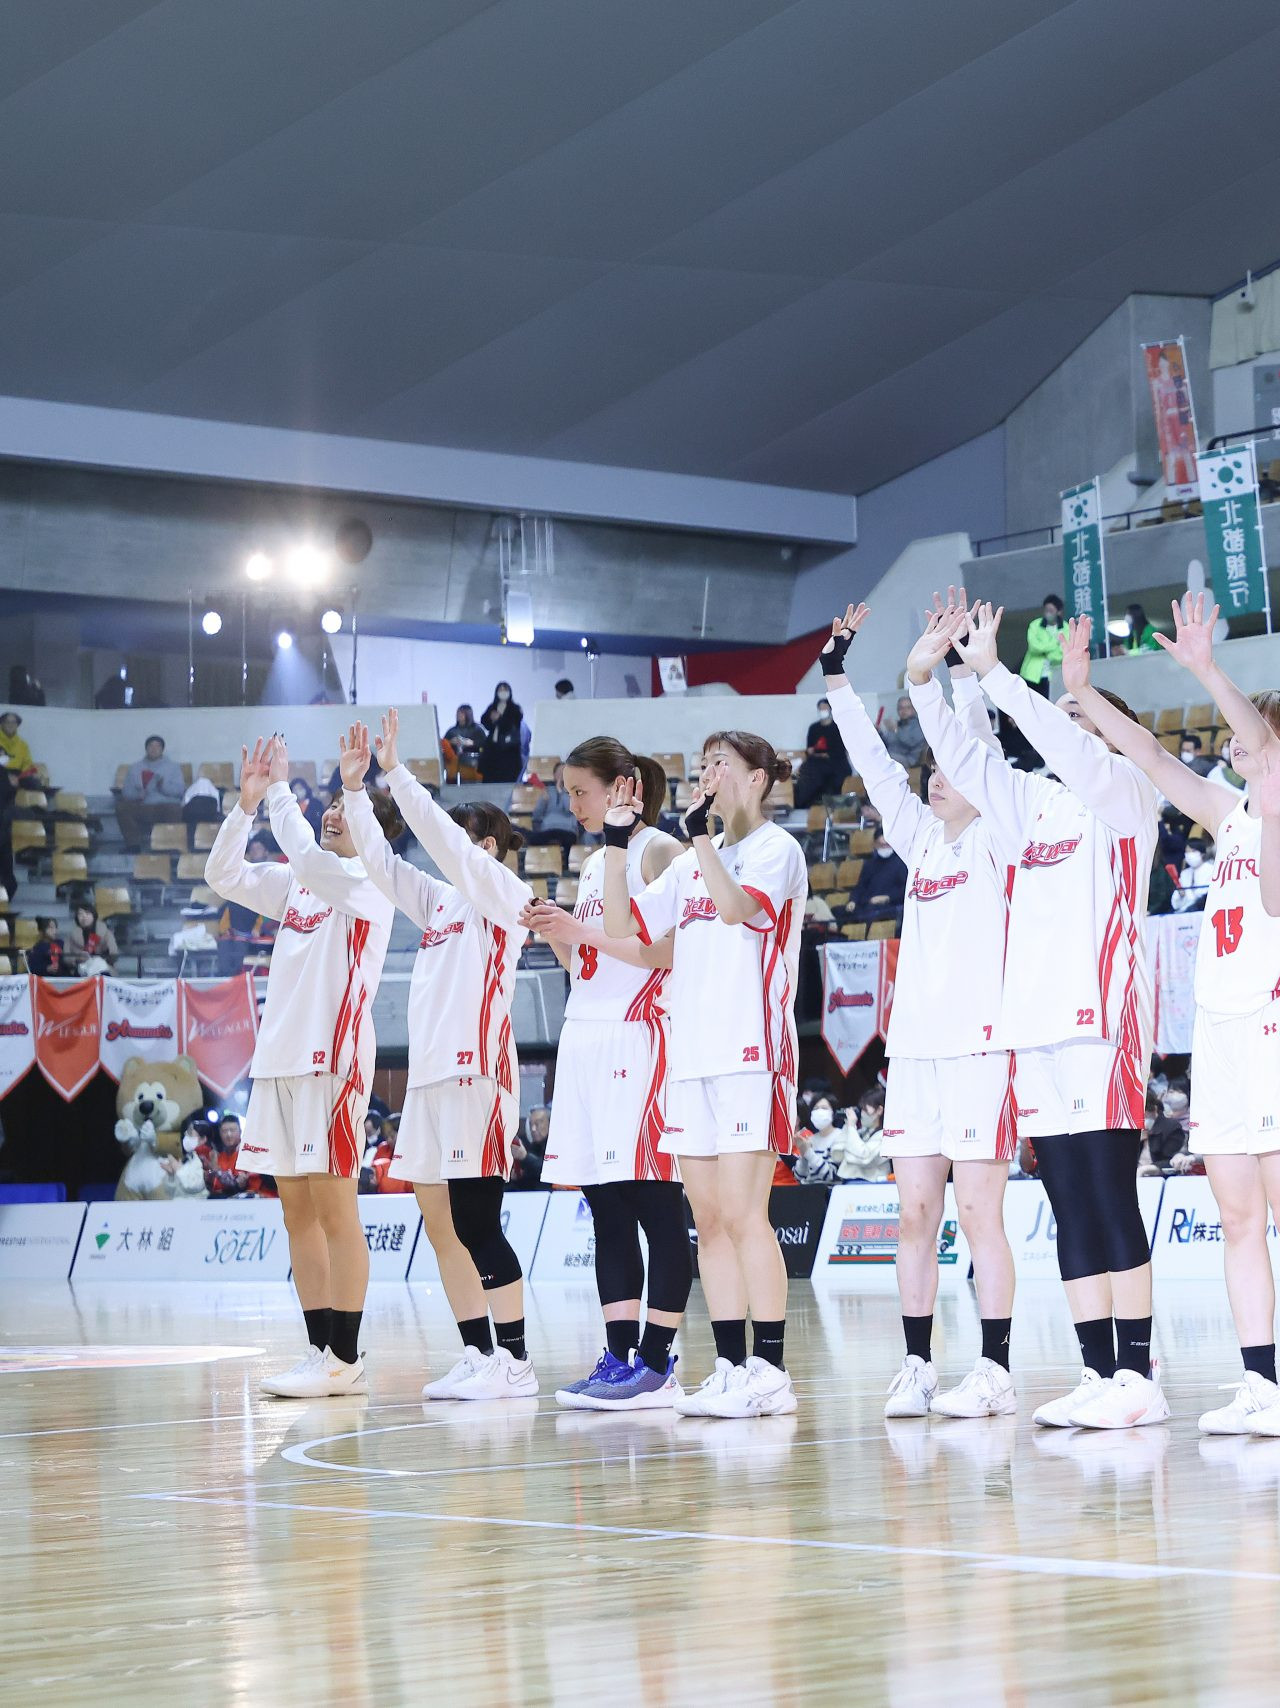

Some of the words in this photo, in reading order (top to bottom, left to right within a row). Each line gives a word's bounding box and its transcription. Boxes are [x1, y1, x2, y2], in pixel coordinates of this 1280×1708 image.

[1077, 1008, 1094, 1026] 22
[983, 1025, 993, 1041] 7
[312, 1051, 326, 1065] 52
[457, 1051, 474, 1065] 27
[742, 1046, 760, 1062] 25
[116, 1227, 175, 1251] 大林組
